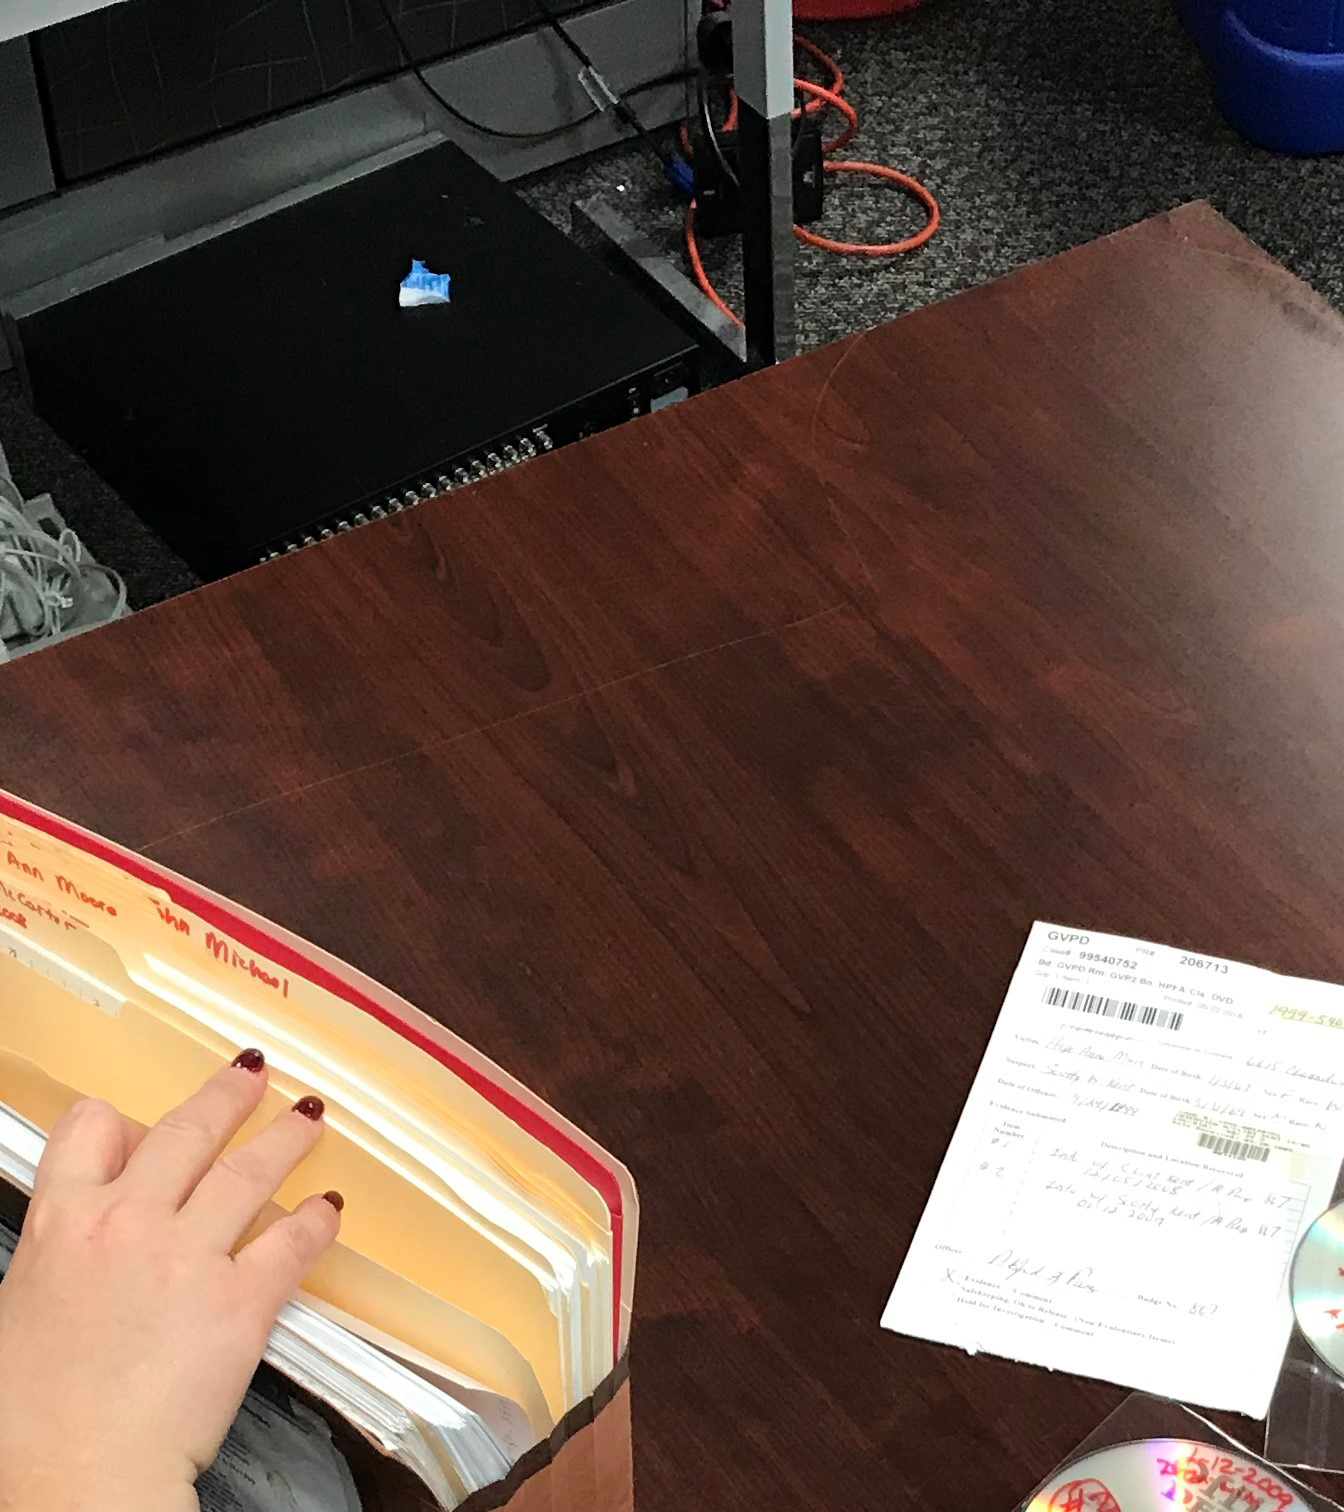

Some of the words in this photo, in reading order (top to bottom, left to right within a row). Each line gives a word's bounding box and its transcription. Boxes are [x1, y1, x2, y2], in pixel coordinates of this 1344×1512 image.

[7, 851, 44, 881] Ann
[205, 932, 289, 998] Michael
[1046, 928, 1091, 947] GVPD
[1178, 955, 1229, 974] 206713
[1077, 949, 1138, 970] 99540752
[1056, 961, 1086, 973] GVPD
[1210, 993, 1234, 1004] DVD
